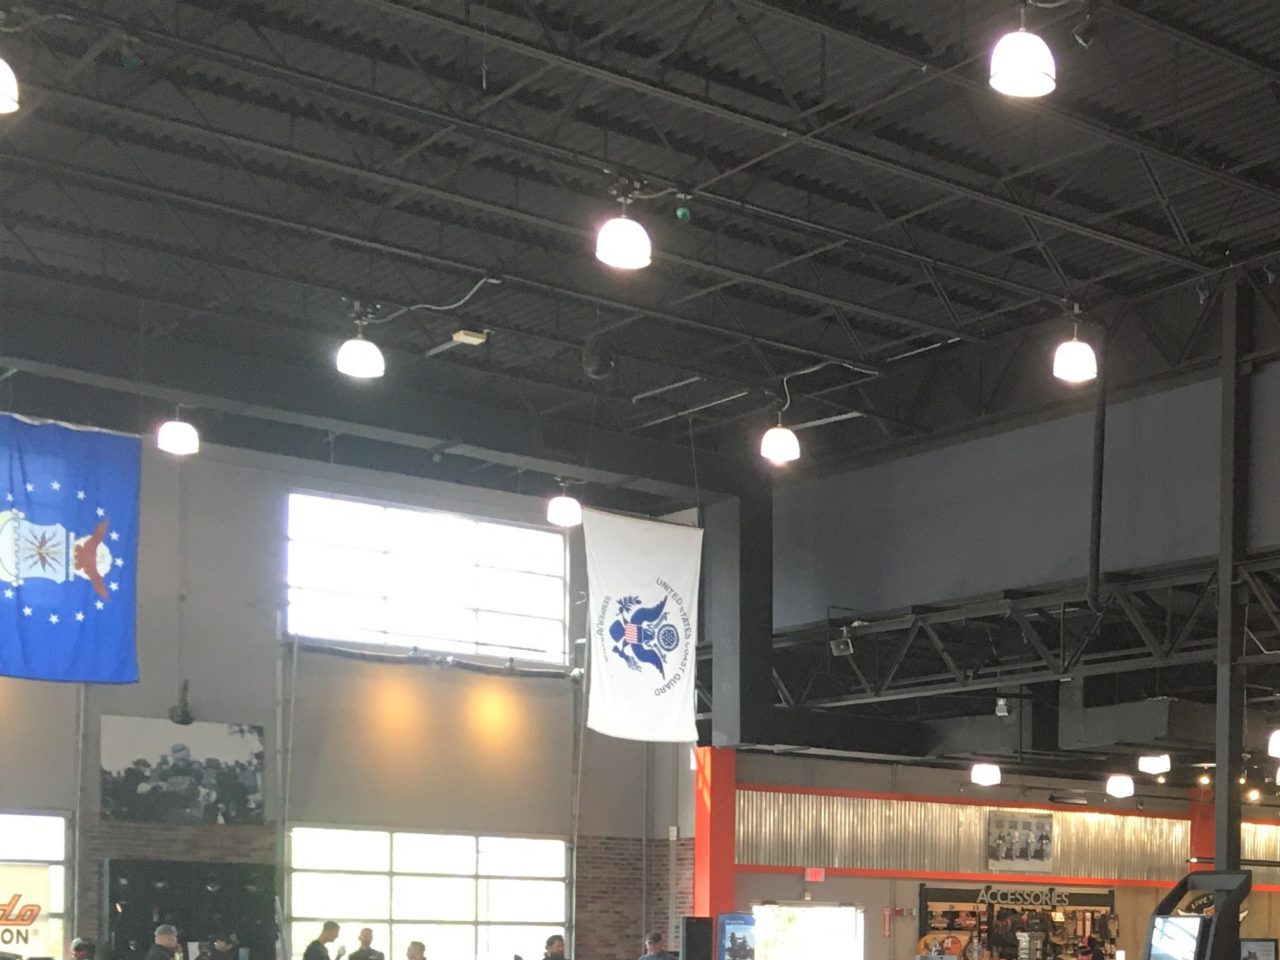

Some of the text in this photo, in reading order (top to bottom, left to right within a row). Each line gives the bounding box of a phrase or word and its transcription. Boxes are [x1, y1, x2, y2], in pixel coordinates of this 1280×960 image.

[656, 577, 682, 606] UNITED
[679, 605, 691, 640] STATES
[654, 673, 682, 697] GUARD
[977, 889, 1070, 906] ACCESSORIES
